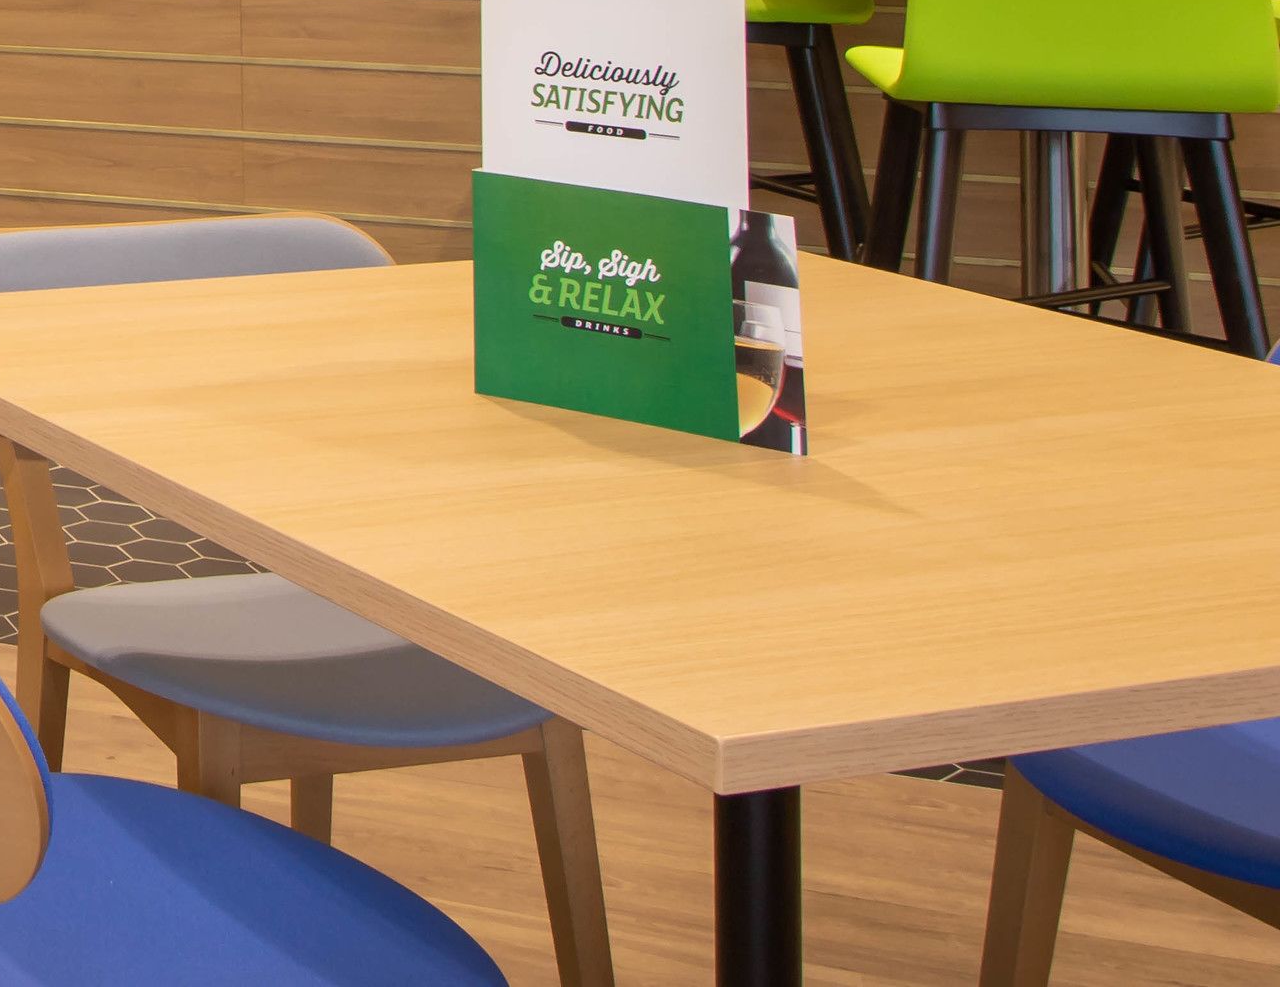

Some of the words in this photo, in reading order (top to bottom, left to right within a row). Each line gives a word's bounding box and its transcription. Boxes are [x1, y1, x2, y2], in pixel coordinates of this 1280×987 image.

[535, 51, 680, 95] Deliciously
[531, 83, 684, 123] SATISFYING
[588, 125, 624, 136] FOOD
[540, 240, 592, 275] Sip,
[598, 249, 661, 286] Sigh
[528, 273, 553, 305] &
[558, 277, 665, 325] RELAX
[575, 319, 630, 336] DRINKS
